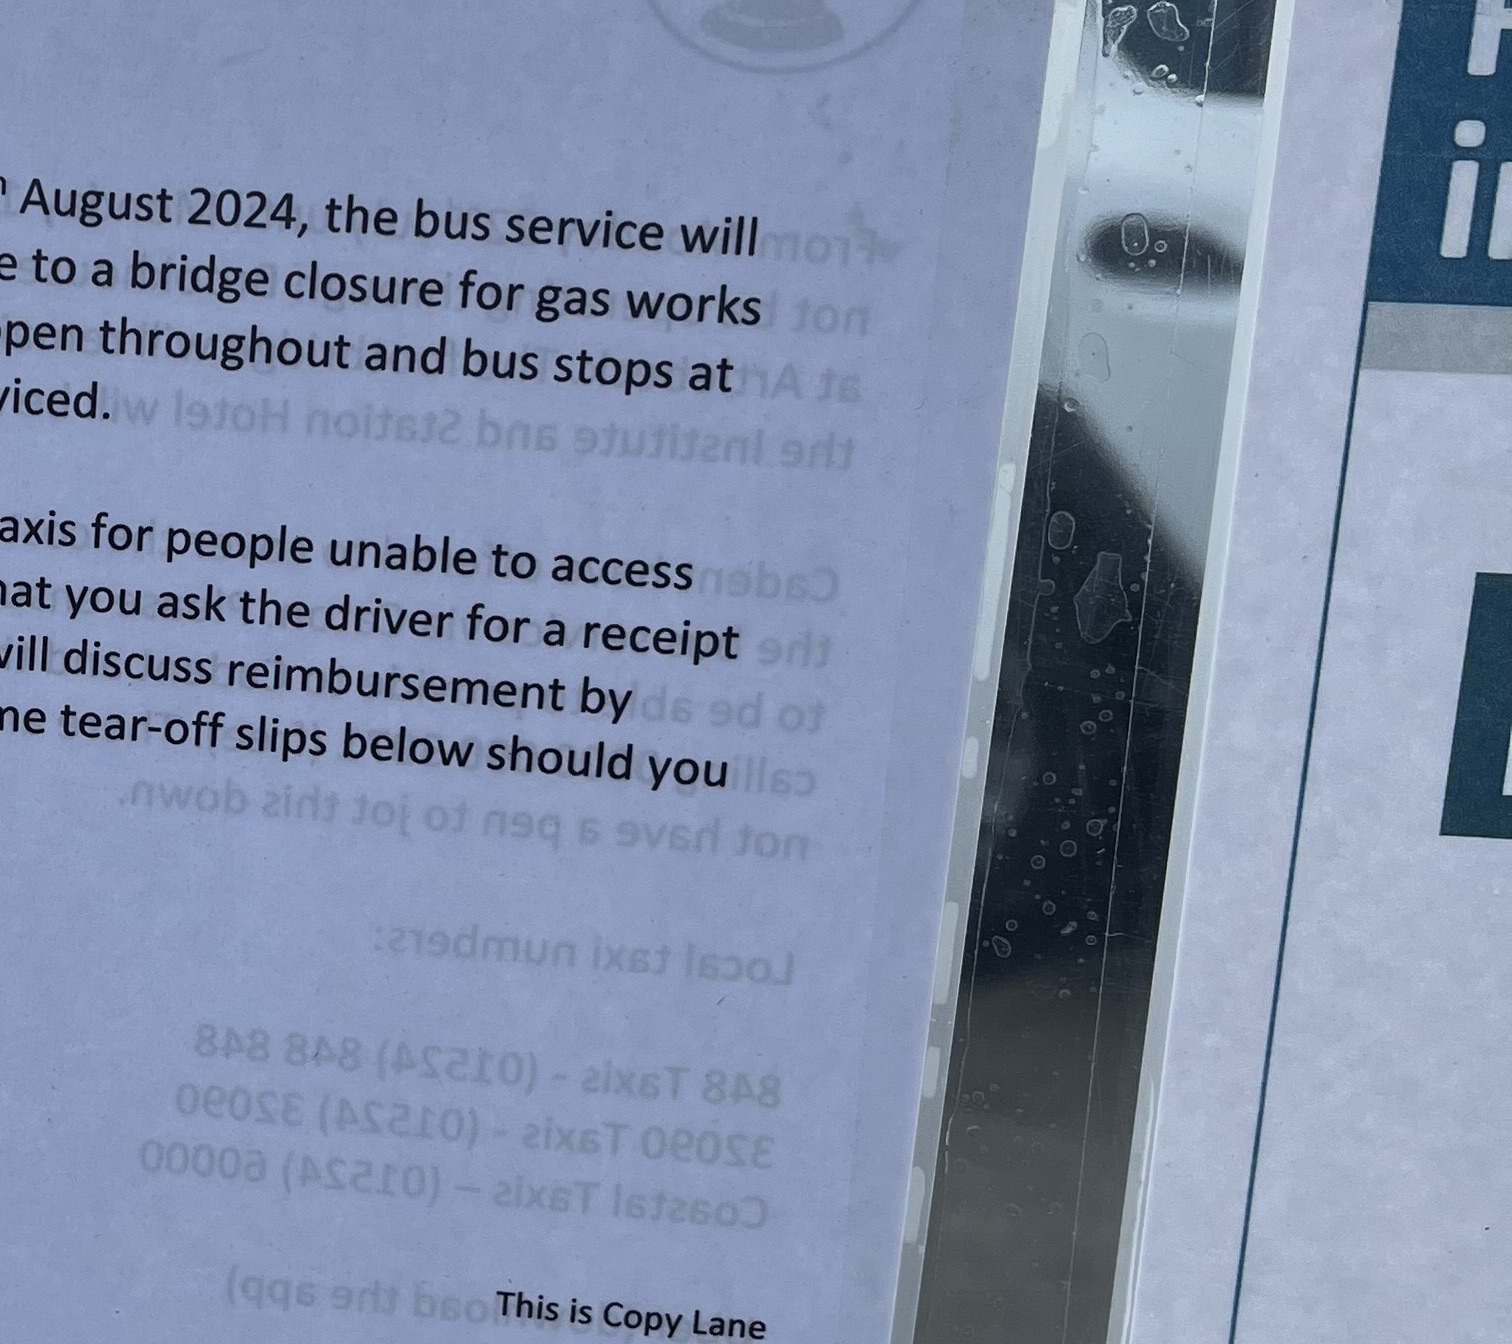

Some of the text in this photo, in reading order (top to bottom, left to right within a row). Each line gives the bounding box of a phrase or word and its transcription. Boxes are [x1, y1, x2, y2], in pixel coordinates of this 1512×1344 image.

[19, 178, 173, 227] August
[188, 188, 307, 238] 2024,
[325, 194, 398, 236] the
[415, 198, 490, 241] bus
[506, 210, 664, 251] service
[681, 216, 758, 256] will
[32, 249, 76, 284] to
[131, 250, 269, 304] bridge
[285, 260, 443, 307] closure
[459, 269, 524, 311] for
[535, 285, 609, 322] gas
[627, 284, 761, 326] works
[99, 316, 351, 371] throughout
[365, 336, 446, 374] and
[463, 338, 538, 380] bus
[554, 350, 672, 396] stops
[689, 358, 734, 392] at
[91, 512, 153, 551] for
[167, 525, 313, 569] people
[330, 534, 477, 575] unable
[491, 544, 536, 579] to
[552, 555, 693, 590] access
[66, 585, 141, 619] you
[157, 584, 226, 622] ask
[240, 588, 310, 628] the
[325, 594, 454, 638] driver
[467, 603, 530, 643] for
[584, 620, 740, 665] receipt
[64, 639, 212, 684] discuss
[228, 655, 565, 711] reimbursement
[581, 676, 633, 724] by
[60, 705, 225, 747] tear-off
[236, 715, 326, 762] slips
[343, 722, 474, 767] below
[487, 735, 633, 780] should
[649, 756, 727, 791] you
[496, 1291, 766, 1340] This is Copy Lane
